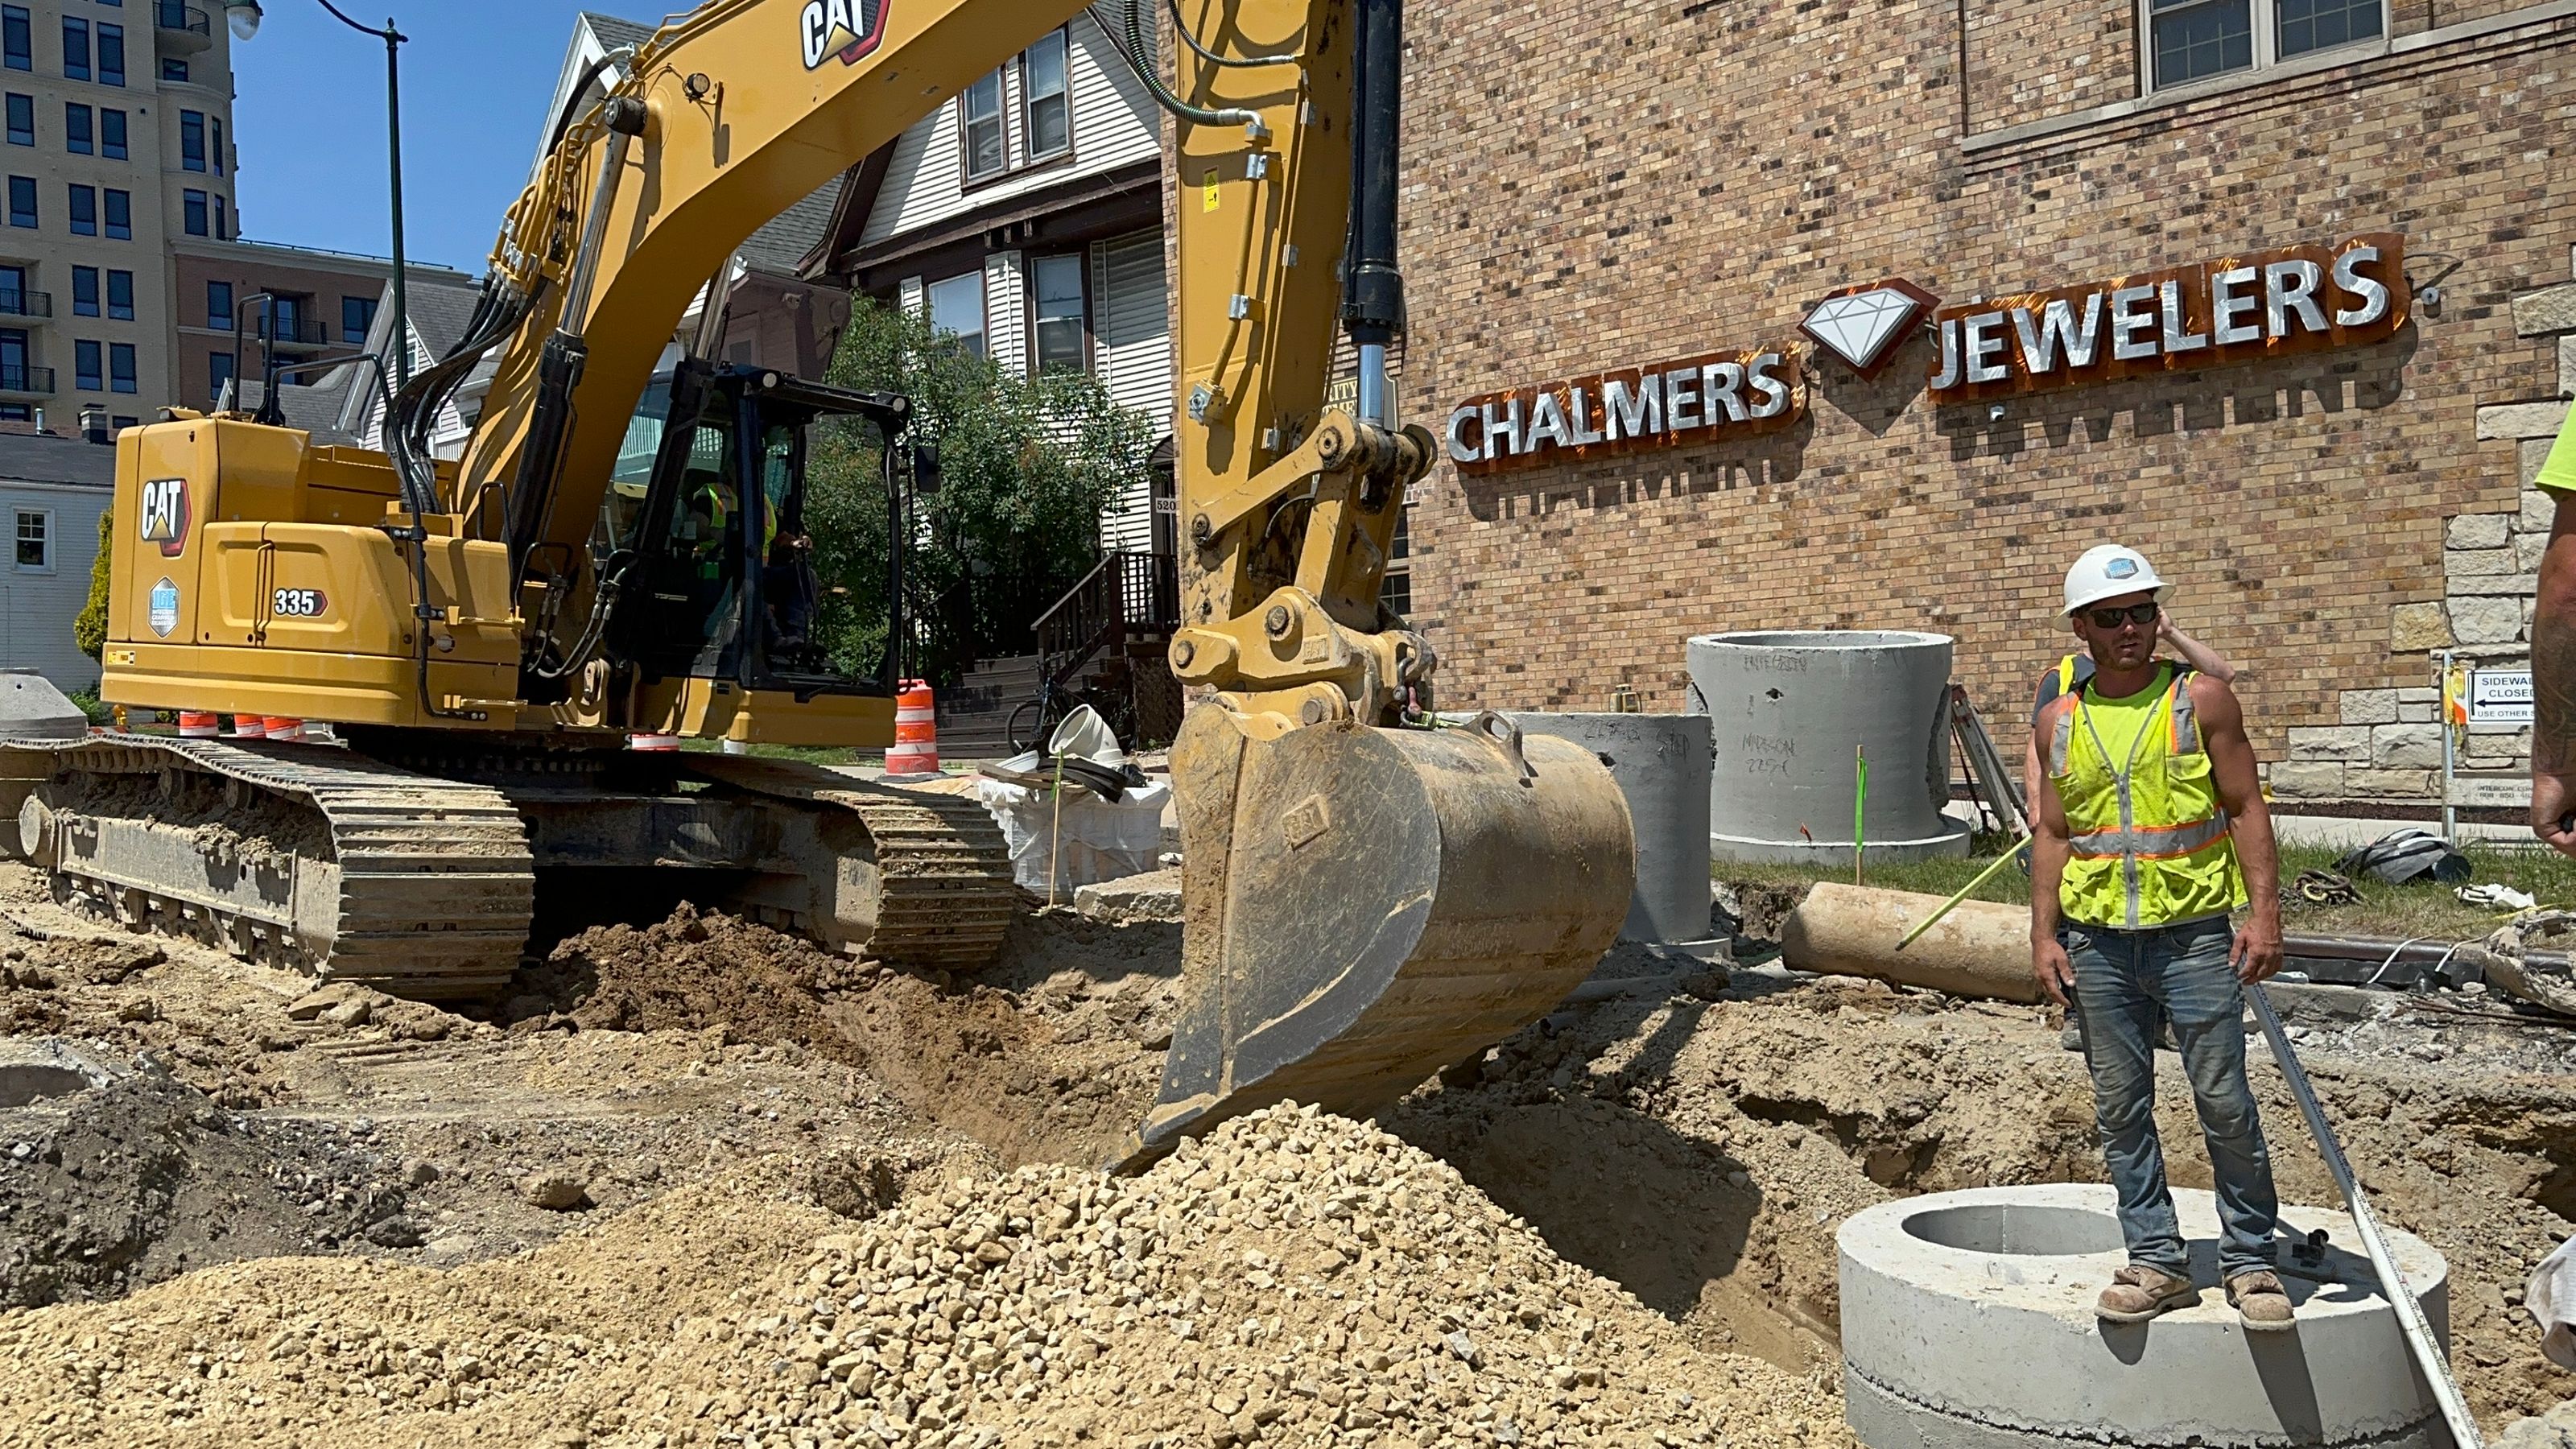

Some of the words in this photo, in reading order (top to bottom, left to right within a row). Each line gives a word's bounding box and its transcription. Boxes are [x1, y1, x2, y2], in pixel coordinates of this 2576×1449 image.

[1446, 353, 1790, 463] CHALMERS
[1930, 246, 2389, 389] JEWELERS
[142, 481, 181, 539] CAT
[1157, 501, 1176, 510] 520
[275, 588, 315, 615] 335
